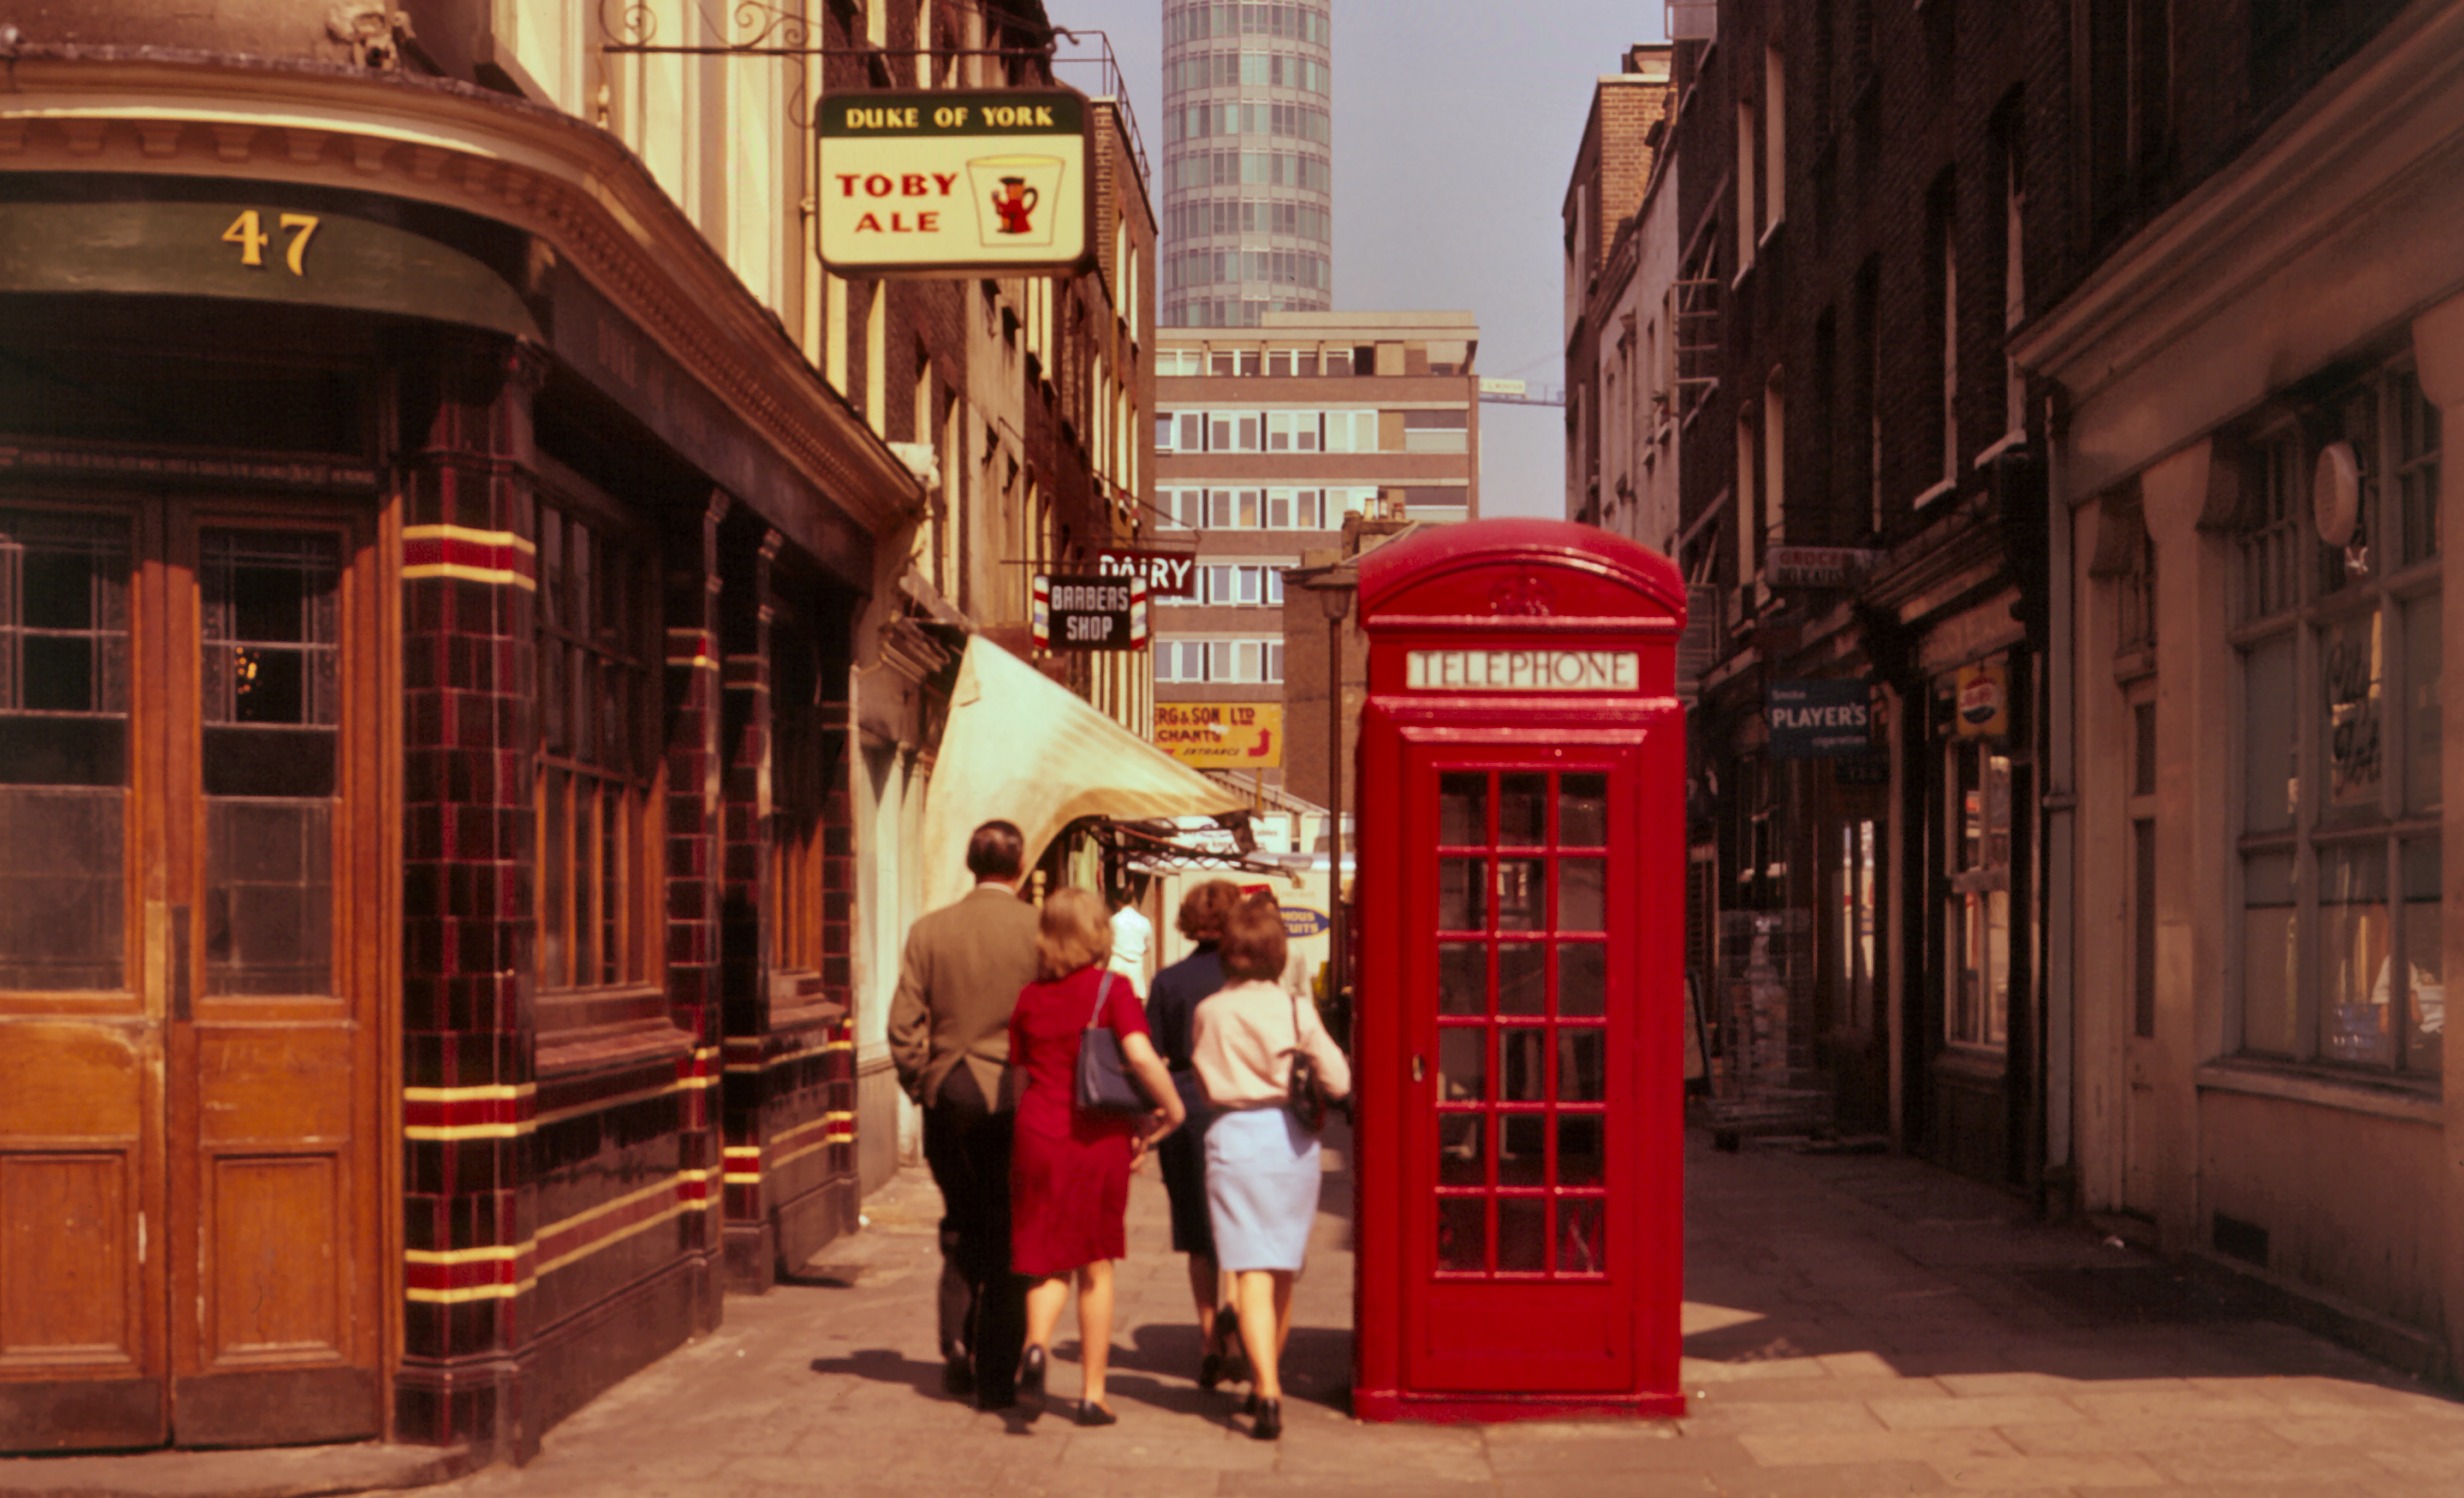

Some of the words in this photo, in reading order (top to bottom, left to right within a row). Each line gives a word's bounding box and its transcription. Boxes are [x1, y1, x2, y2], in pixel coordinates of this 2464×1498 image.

[846, 108, 919, 129] DUKE
[933, 107, 968, 127] OF
[981, 106, 1054, 127] YORK
[836, 173, 958, 198] TOBY
[856, 212, 940, 233] ALE
[222, 209, 319, 277] 47
[1051, 585, 1129, 611] BARBERS
[1066, 615, 1113, 641] SHOP
[1412, 651, 1630, 686] TELEPHONE
[1191, 707, 1220, 725] SON
[1230, 707, 1255, 725] LTD
[1772, 701, 1867, 729] PLAYER'S
